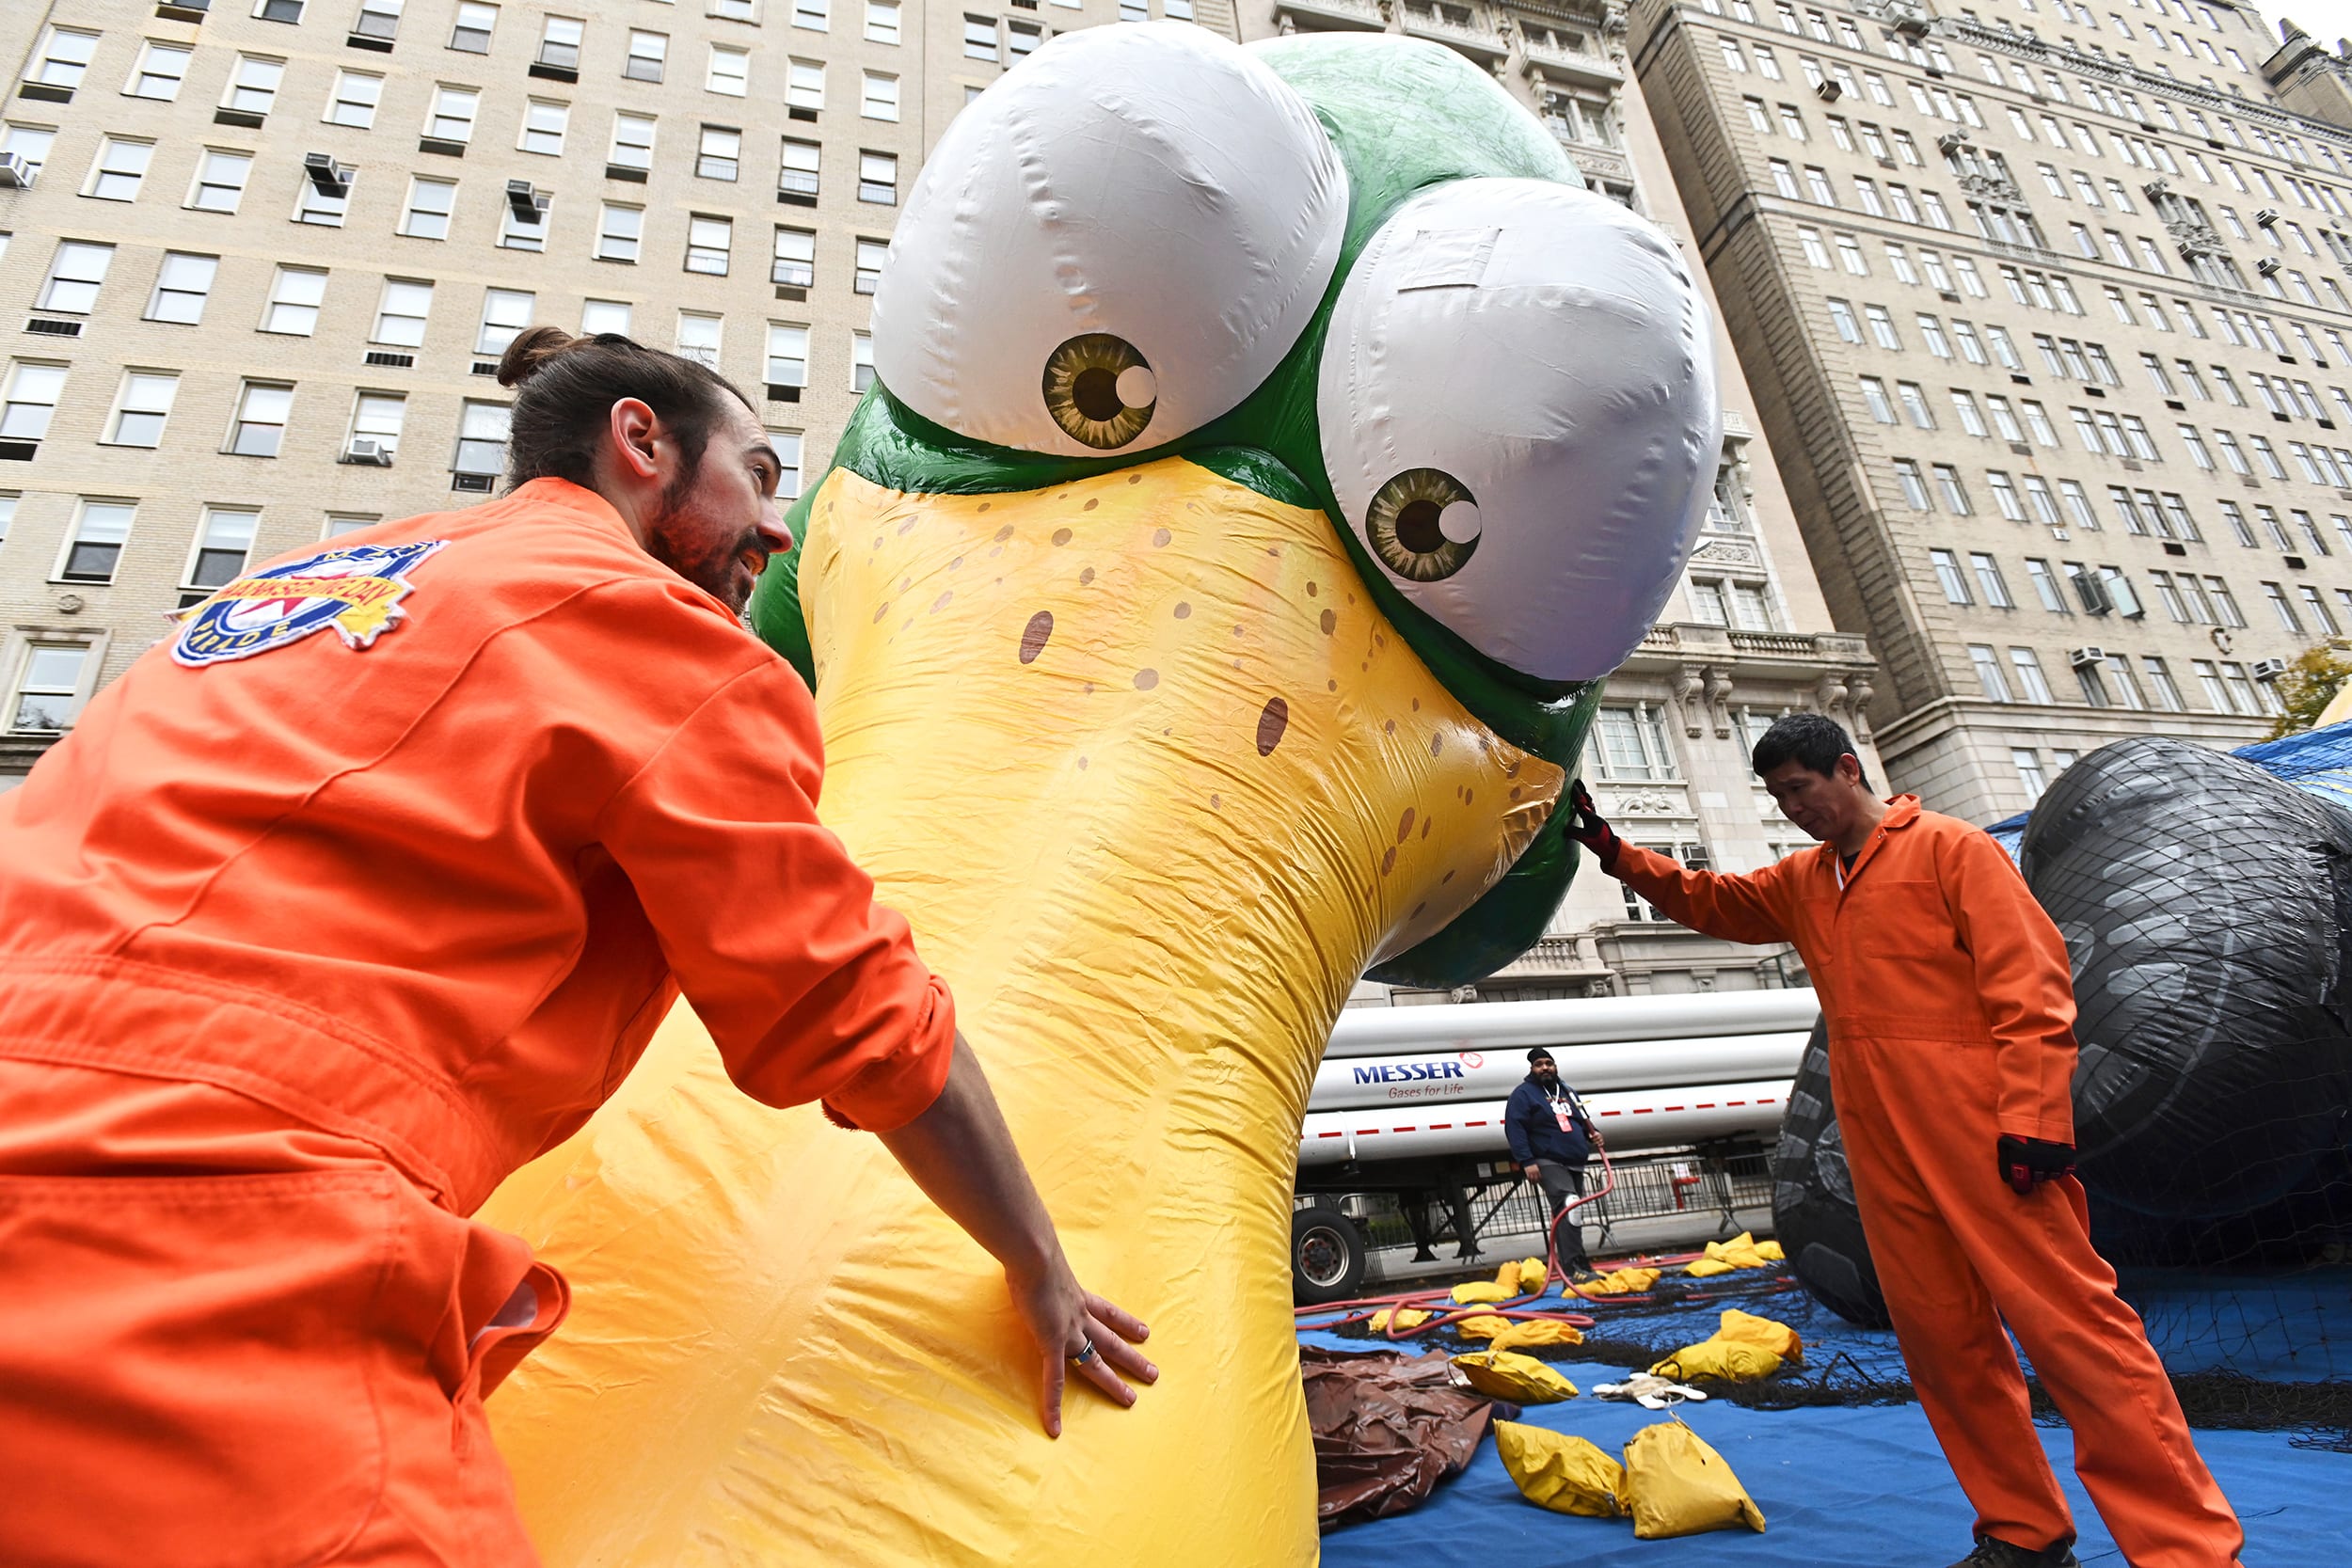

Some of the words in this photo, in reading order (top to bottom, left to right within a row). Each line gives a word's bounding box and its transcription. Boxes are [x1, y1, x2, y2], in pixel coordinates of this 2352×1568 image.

[341, 580, 398, 607] DAY
[190, 618, 291, 652] PARADE
[1353, 1061, 1465, 1085] MESSER
[1389, 1086, 1422, 1100] Gases
[1424, 1085, 1440, 1097] for
[1444, 1083, 1464, 1096] Life
